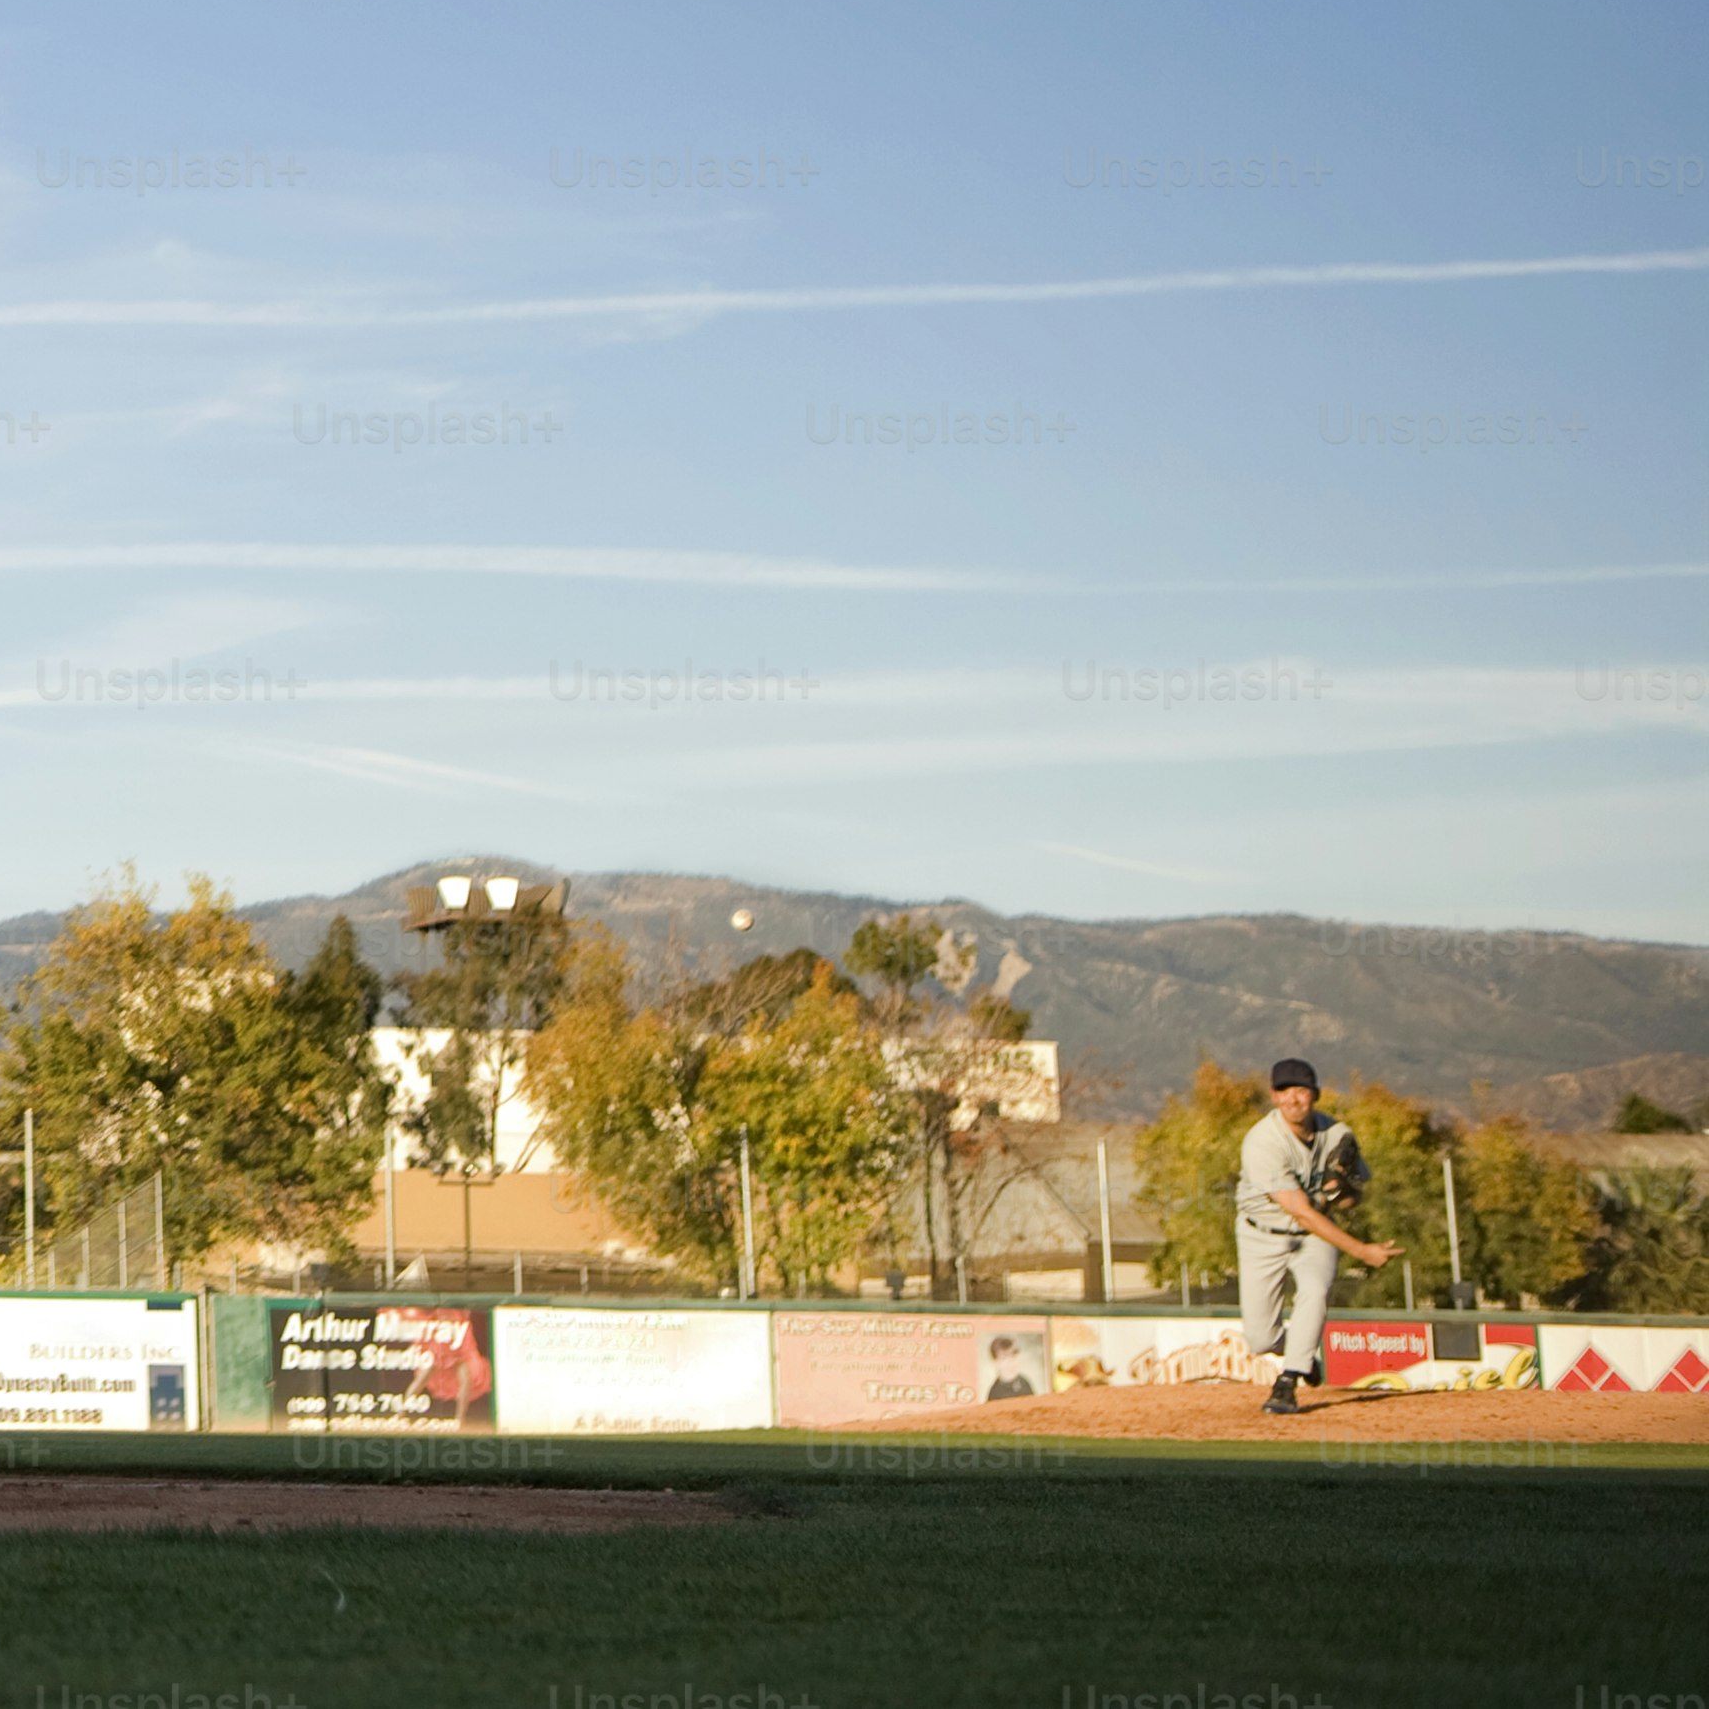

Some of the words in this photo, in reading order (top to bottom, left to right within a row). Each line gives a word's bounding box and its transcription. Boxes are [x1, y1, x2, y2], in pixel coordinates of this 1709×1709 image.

[281, 1312, 371, 1342] Arthur
[373, 1312, 470, 1351] Murray
[778, 1318, 816, 1336] The
[820, 1319, 858, 1336] Sue
[921, 1320, 975, 1338] Team
[281, 1344, 357, 1370] Dance
[359, 1344, 435, 1370] Studio
[1330, 1331, 1366, 1351] Pitch
[1367, 1332, 1408, 1355] Speed
[1409, 1333, 1426, 1358] by
[862, 1380, 939, 1404] Turns
[942, 1381, 976, 1404] To
